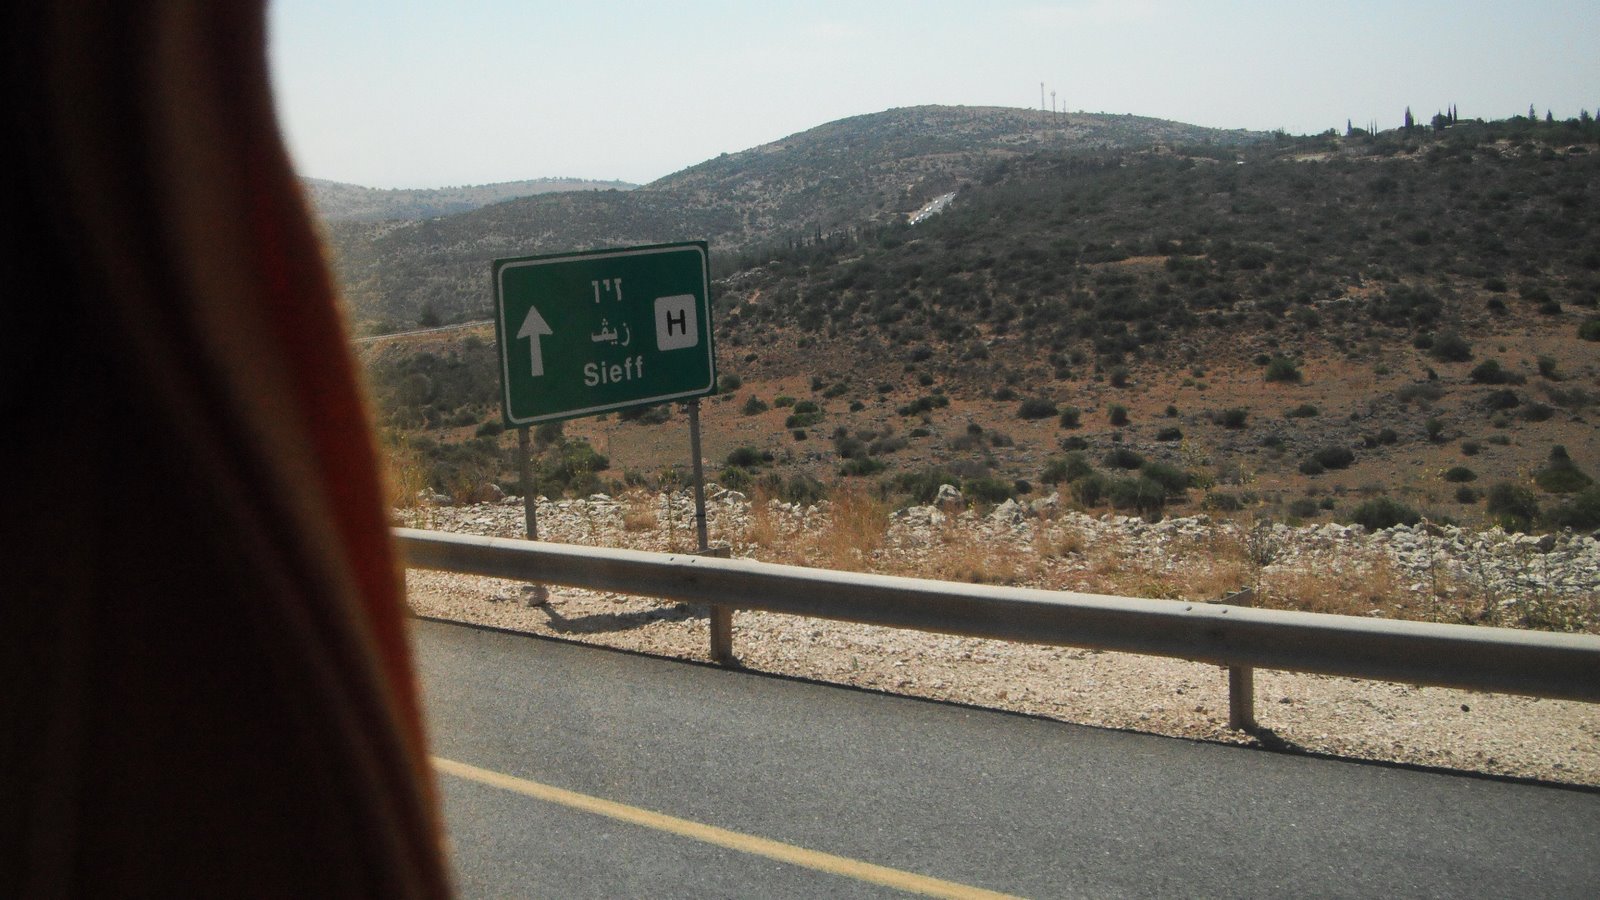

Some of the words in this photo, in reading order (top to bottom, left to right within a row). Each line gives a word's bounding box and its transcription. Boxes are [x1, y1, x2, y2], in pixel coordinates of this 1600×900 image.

[591, 278, 622, 303] זיו
[666, 309, 686, 337] H
[583, 355, 643, 387] Sieff
